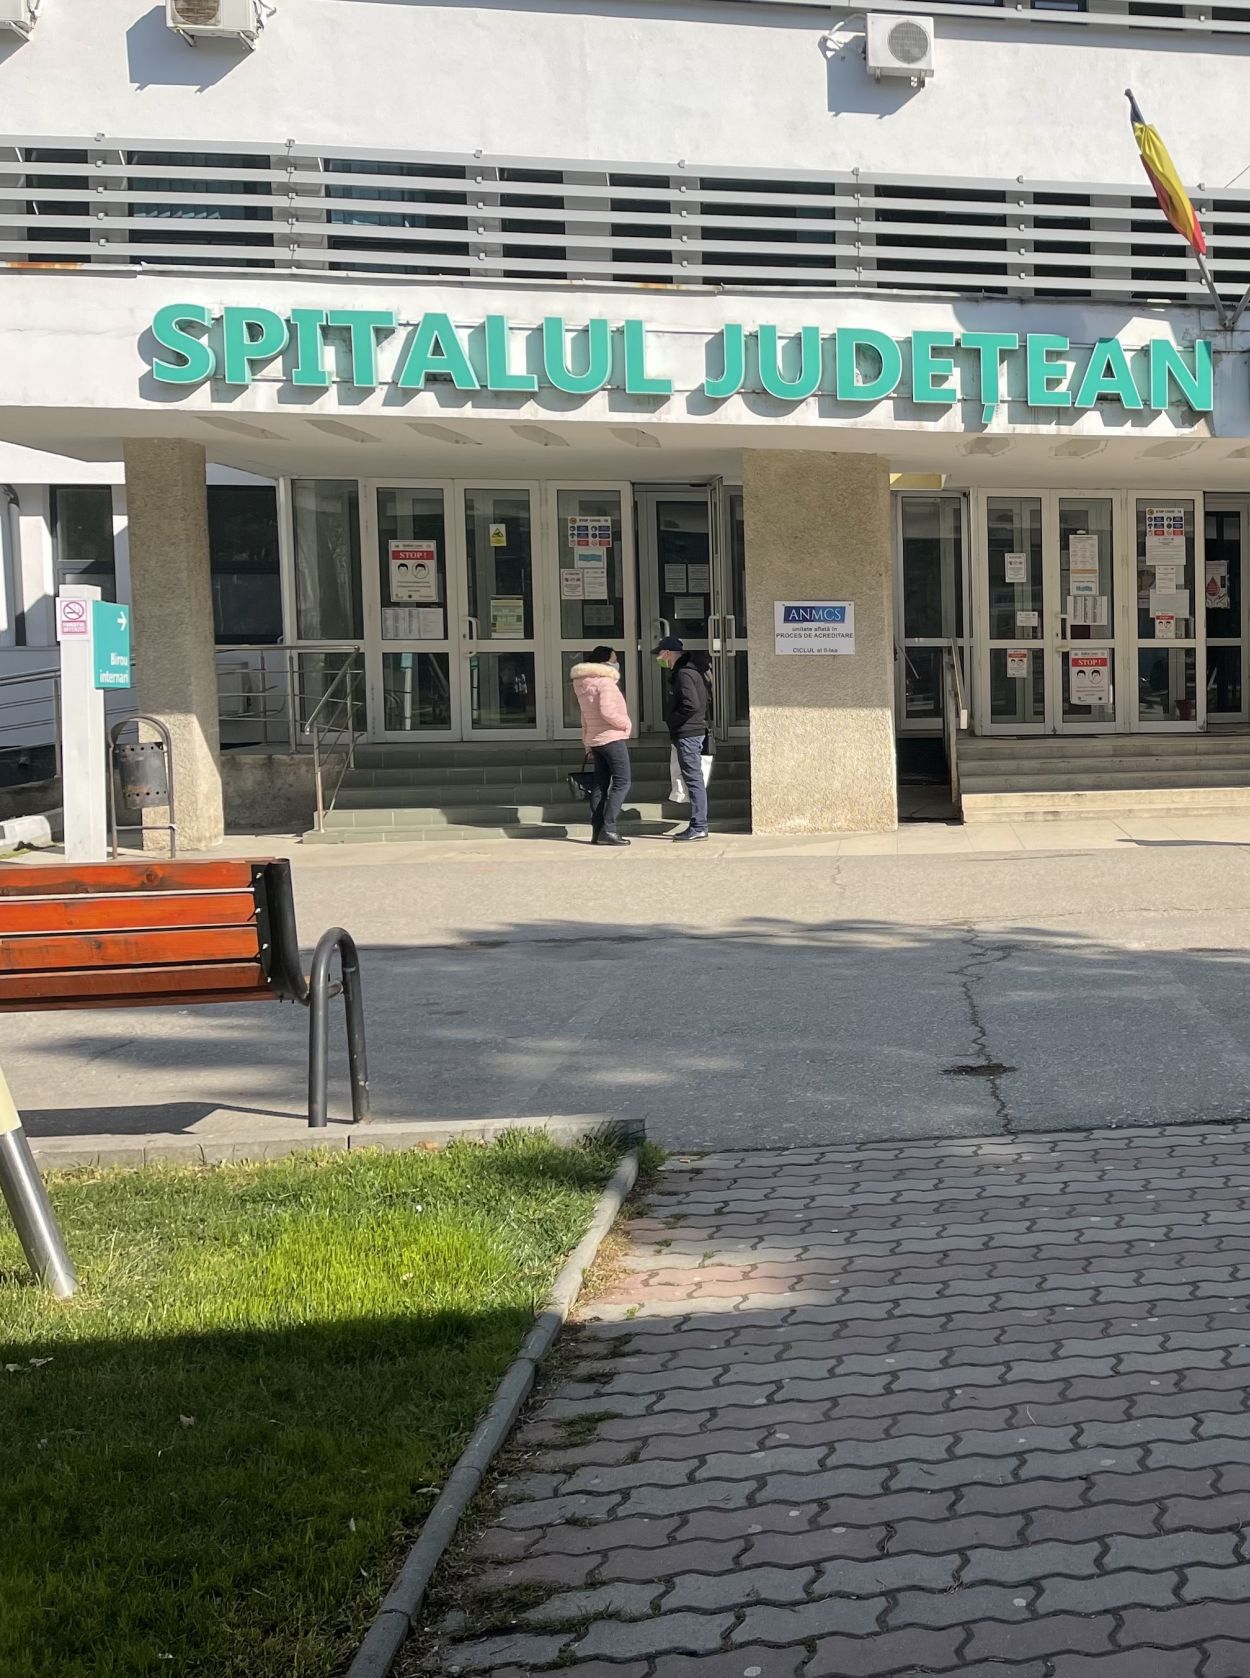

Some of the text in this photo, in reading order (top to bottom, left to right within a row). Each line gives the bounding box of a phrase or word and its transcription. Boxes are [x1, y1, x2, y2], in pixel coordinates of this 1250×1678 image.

[151, 303, 674, 396] SPITALUL
[788, 608, 842, 621] ANMCS
[110, 651, 128, 666] Birou
